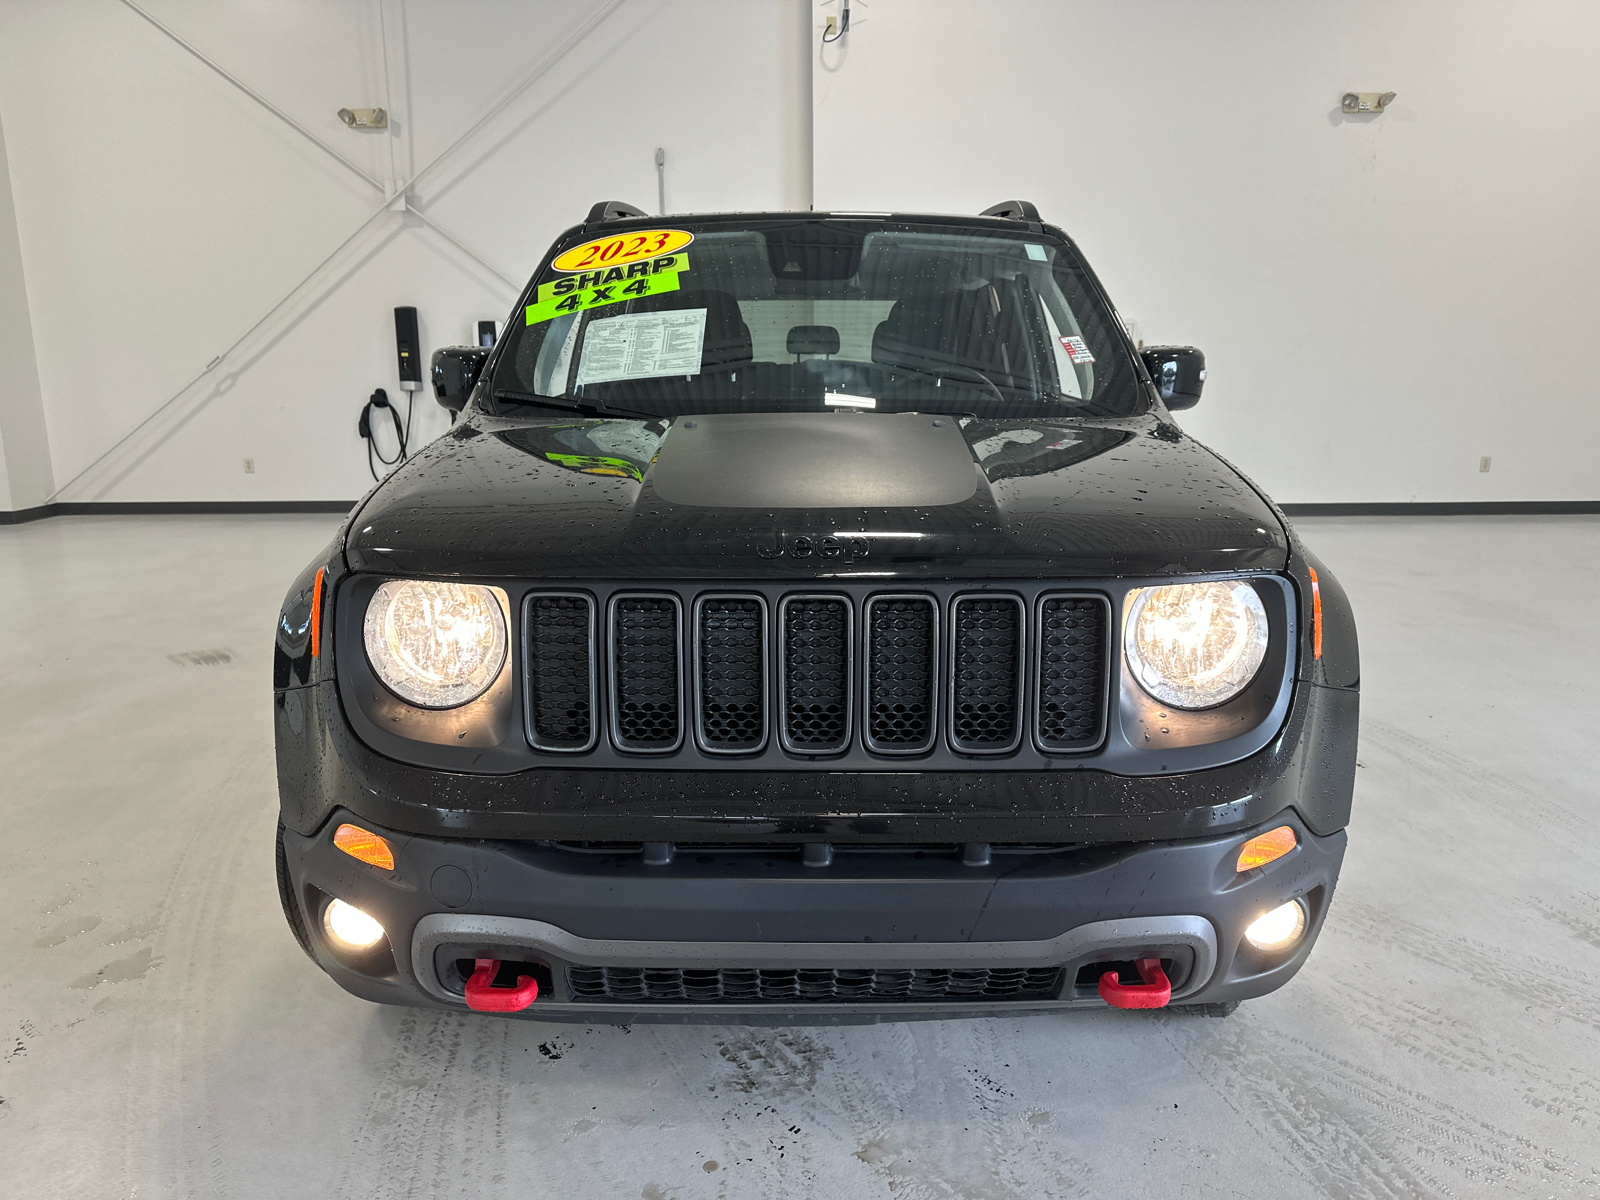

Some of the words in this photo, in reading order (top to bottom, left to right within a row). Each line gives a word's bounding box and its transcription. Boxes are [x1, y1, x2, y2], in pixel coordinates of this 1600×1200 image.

[575, 232, 671, 268] 2023
[552, 256, 678, 296] SHARP
[554, 293, 583, 312] 4
[622, 279, 651, 297] 4
[756, 530, 870, 565] Jeep
